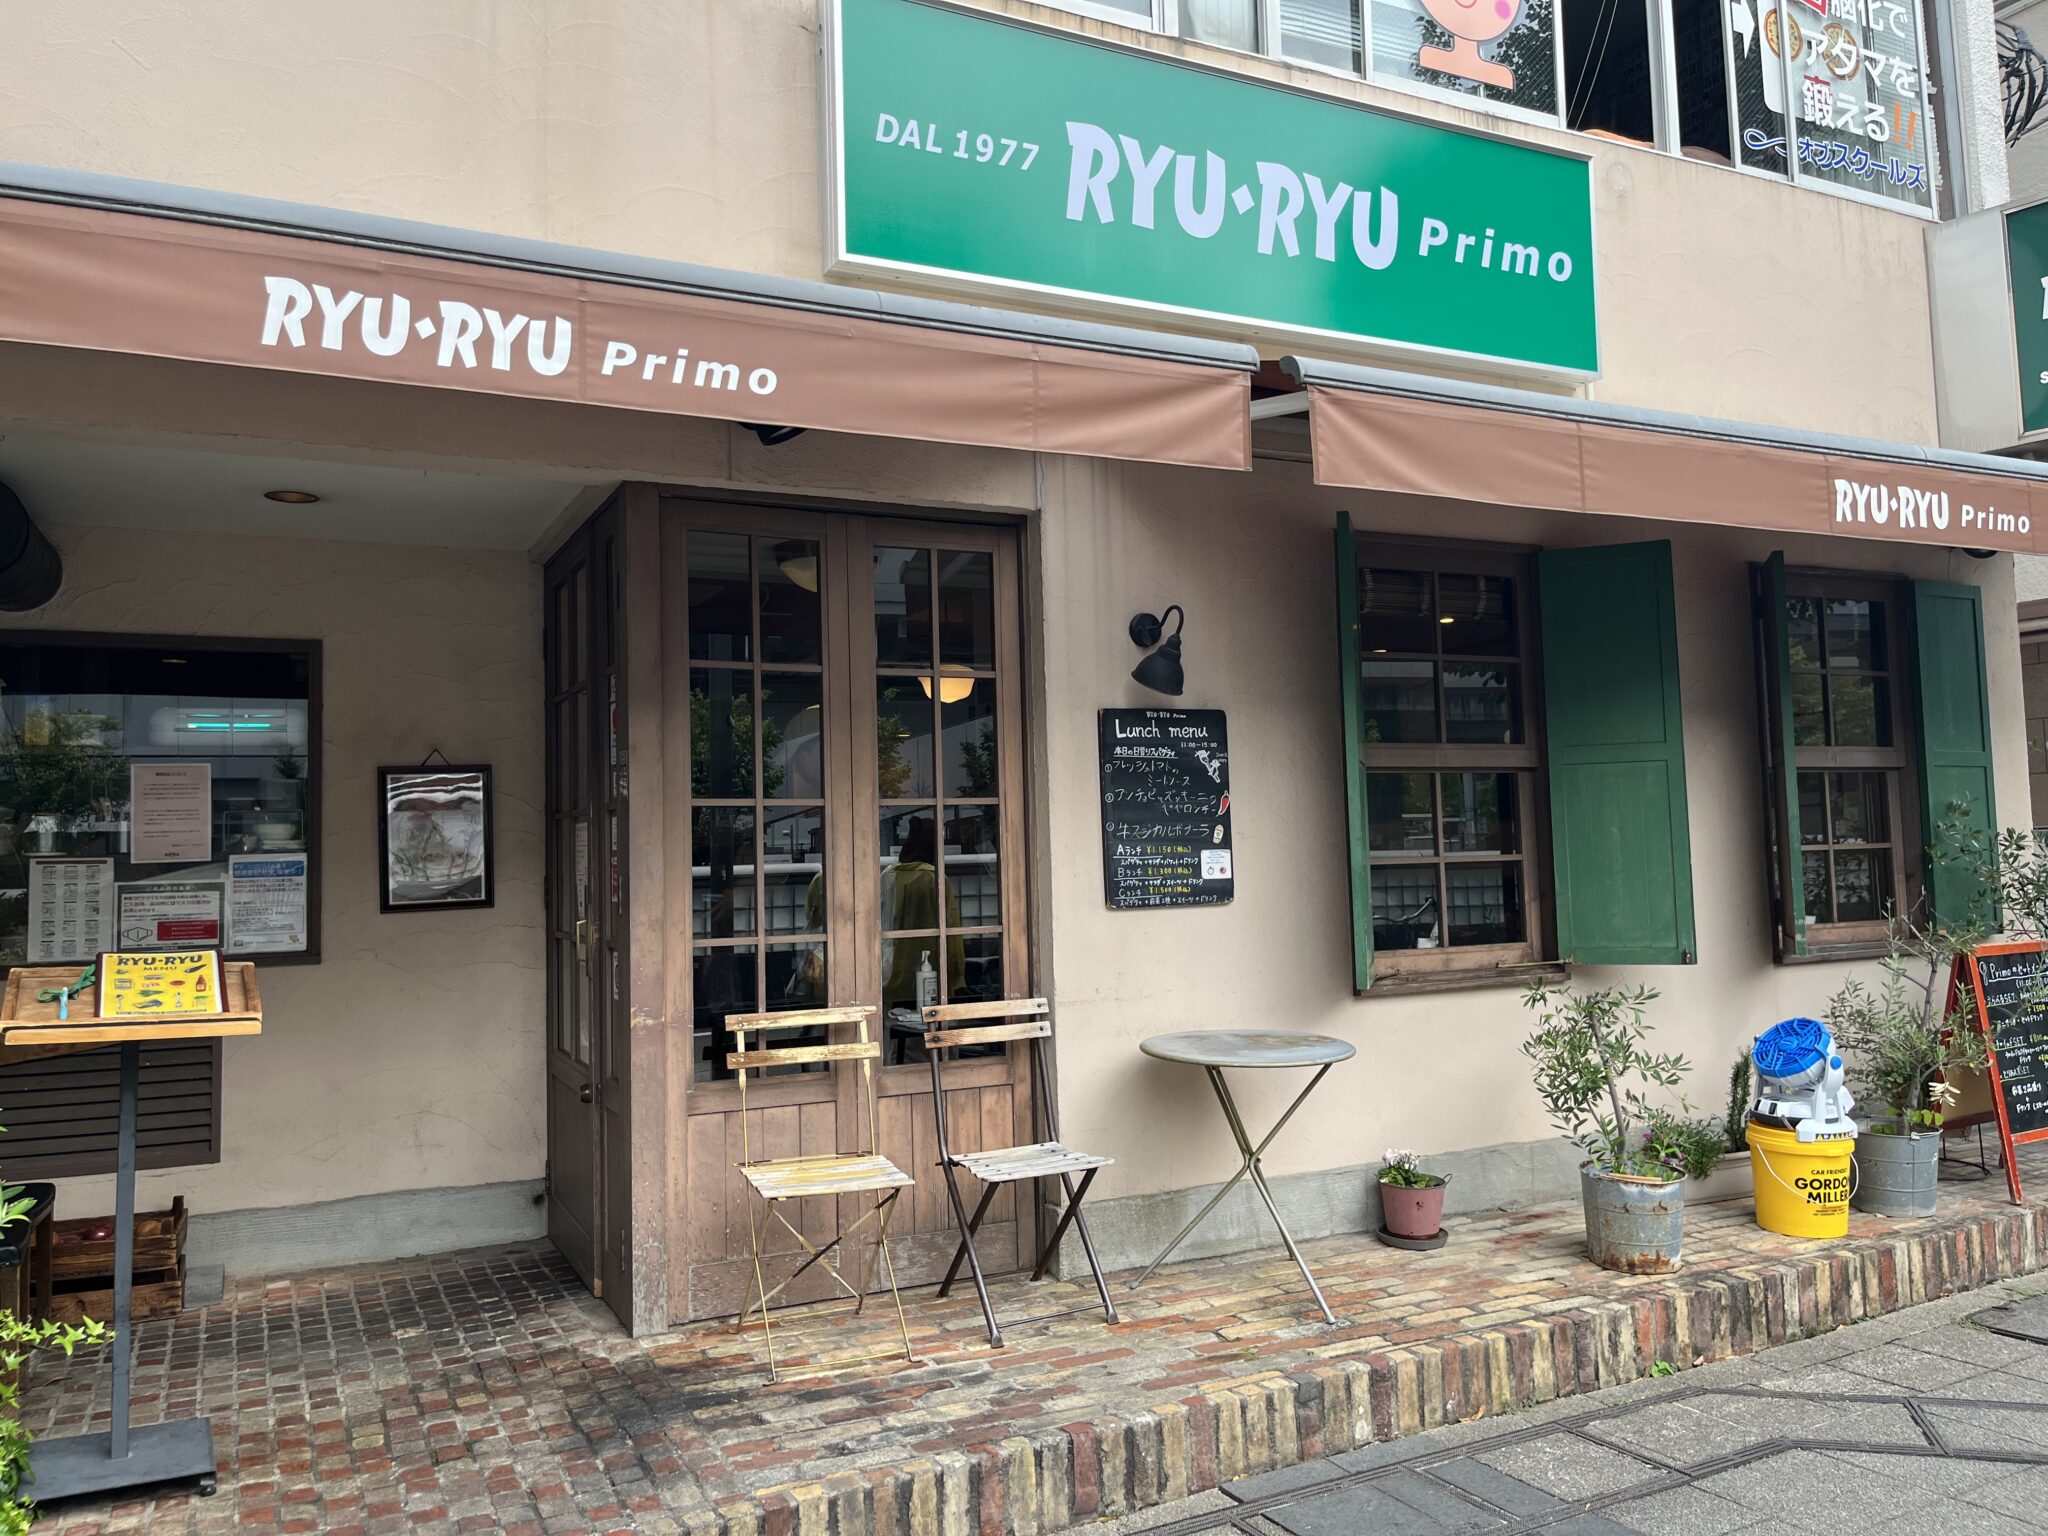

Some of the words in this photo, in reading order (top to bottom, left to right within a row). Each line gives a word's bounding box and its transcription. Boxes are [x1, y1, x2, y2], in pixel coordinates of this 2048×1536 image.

[1801, 28, 1916, 98] アタマを
[875, 112, 943, 154] DAL
[953, 129, 1040, 171] 1977
[1419, 217, 1573, 283] Primo
[601, 341, 778, 396] Primo
[1961, 505, 2030, 534] Primo
[1115, 718, 1161, 738] Lunch
[1168, 726, 1209, 738] menu
[1147, 773, 1191, 787] ミートソース
[1116, 822, 1210, 840] 牛スジカルボナーラ
[1795, 1176, 1849, 1190] GORDO
